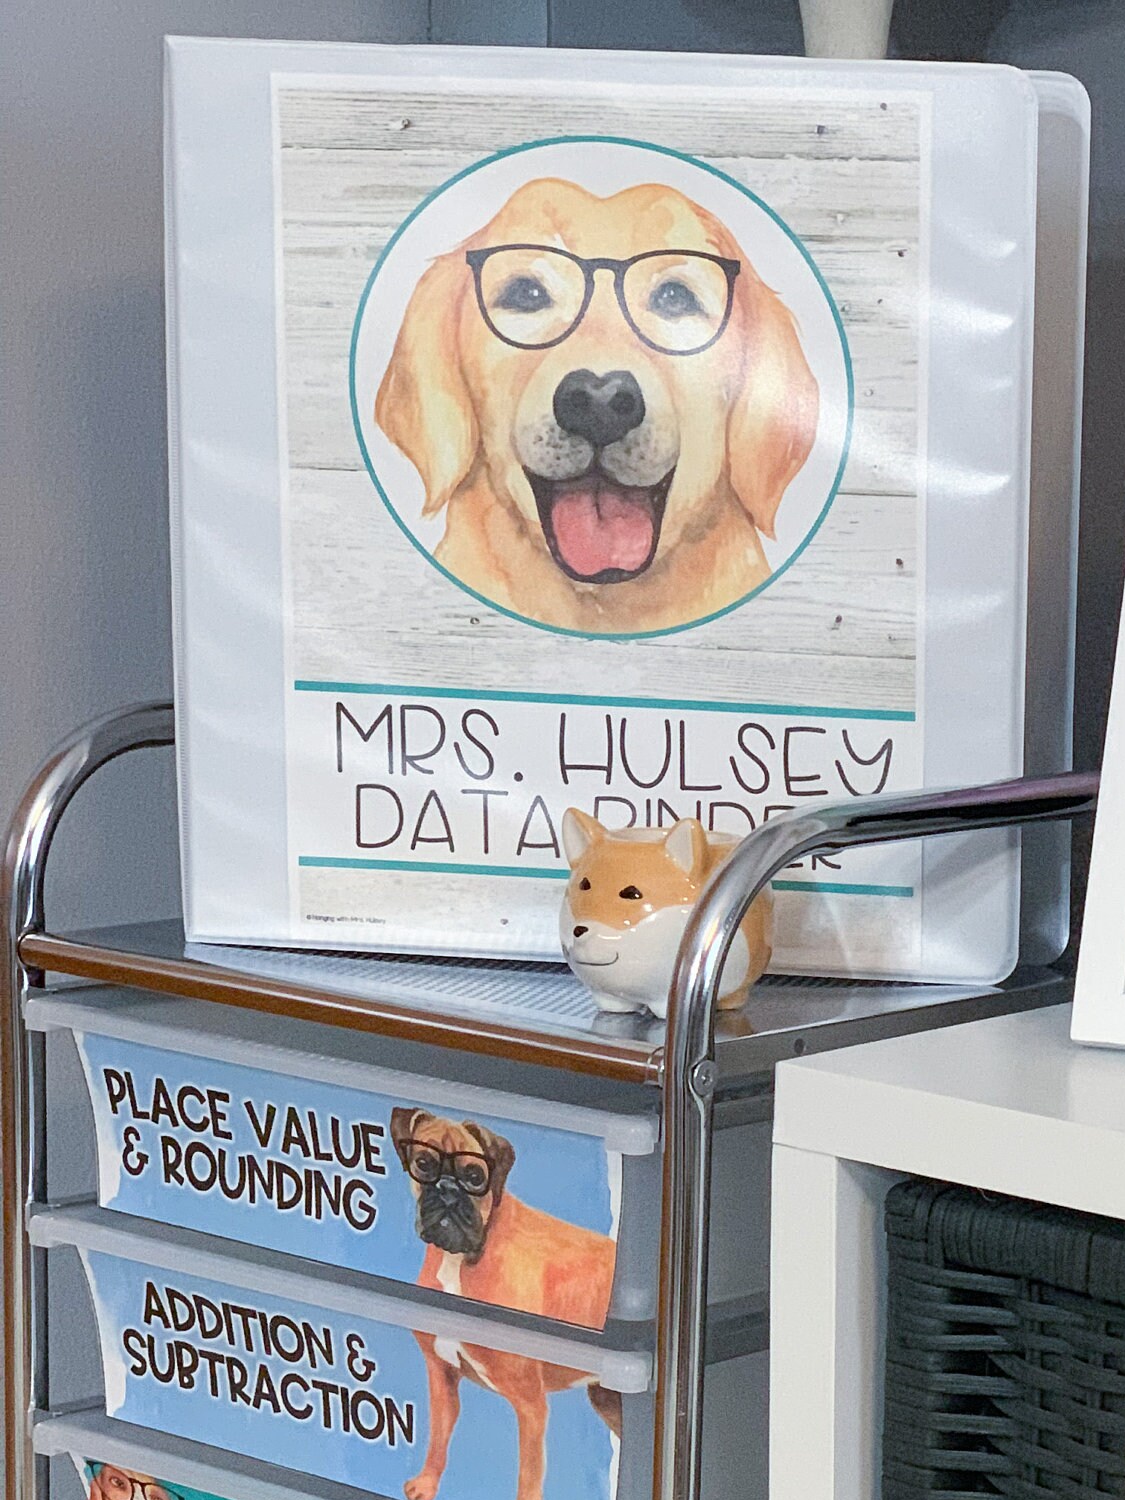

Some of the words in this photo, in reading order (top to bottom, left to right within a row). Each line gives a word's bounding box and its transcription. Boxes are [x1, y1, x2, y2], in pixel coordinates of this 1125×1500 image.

[335, 701, 524, 783] MRS.
[559, 711, 894, 796] HULSEY
[355, 784, 562, 858] DATA
[103, 1068, 233, 1140] PLACE
[244, 1101, 386, 1175] VALUE
[122, 1126, 149, 1176] &
[162, 1137, 377, 1231] ROUNDING
[143, 1281, 333, 1368] ADDITION
[346, 1334, 376, 1382] &
[122, 1328, 414, 1446] SUBTRACTION
